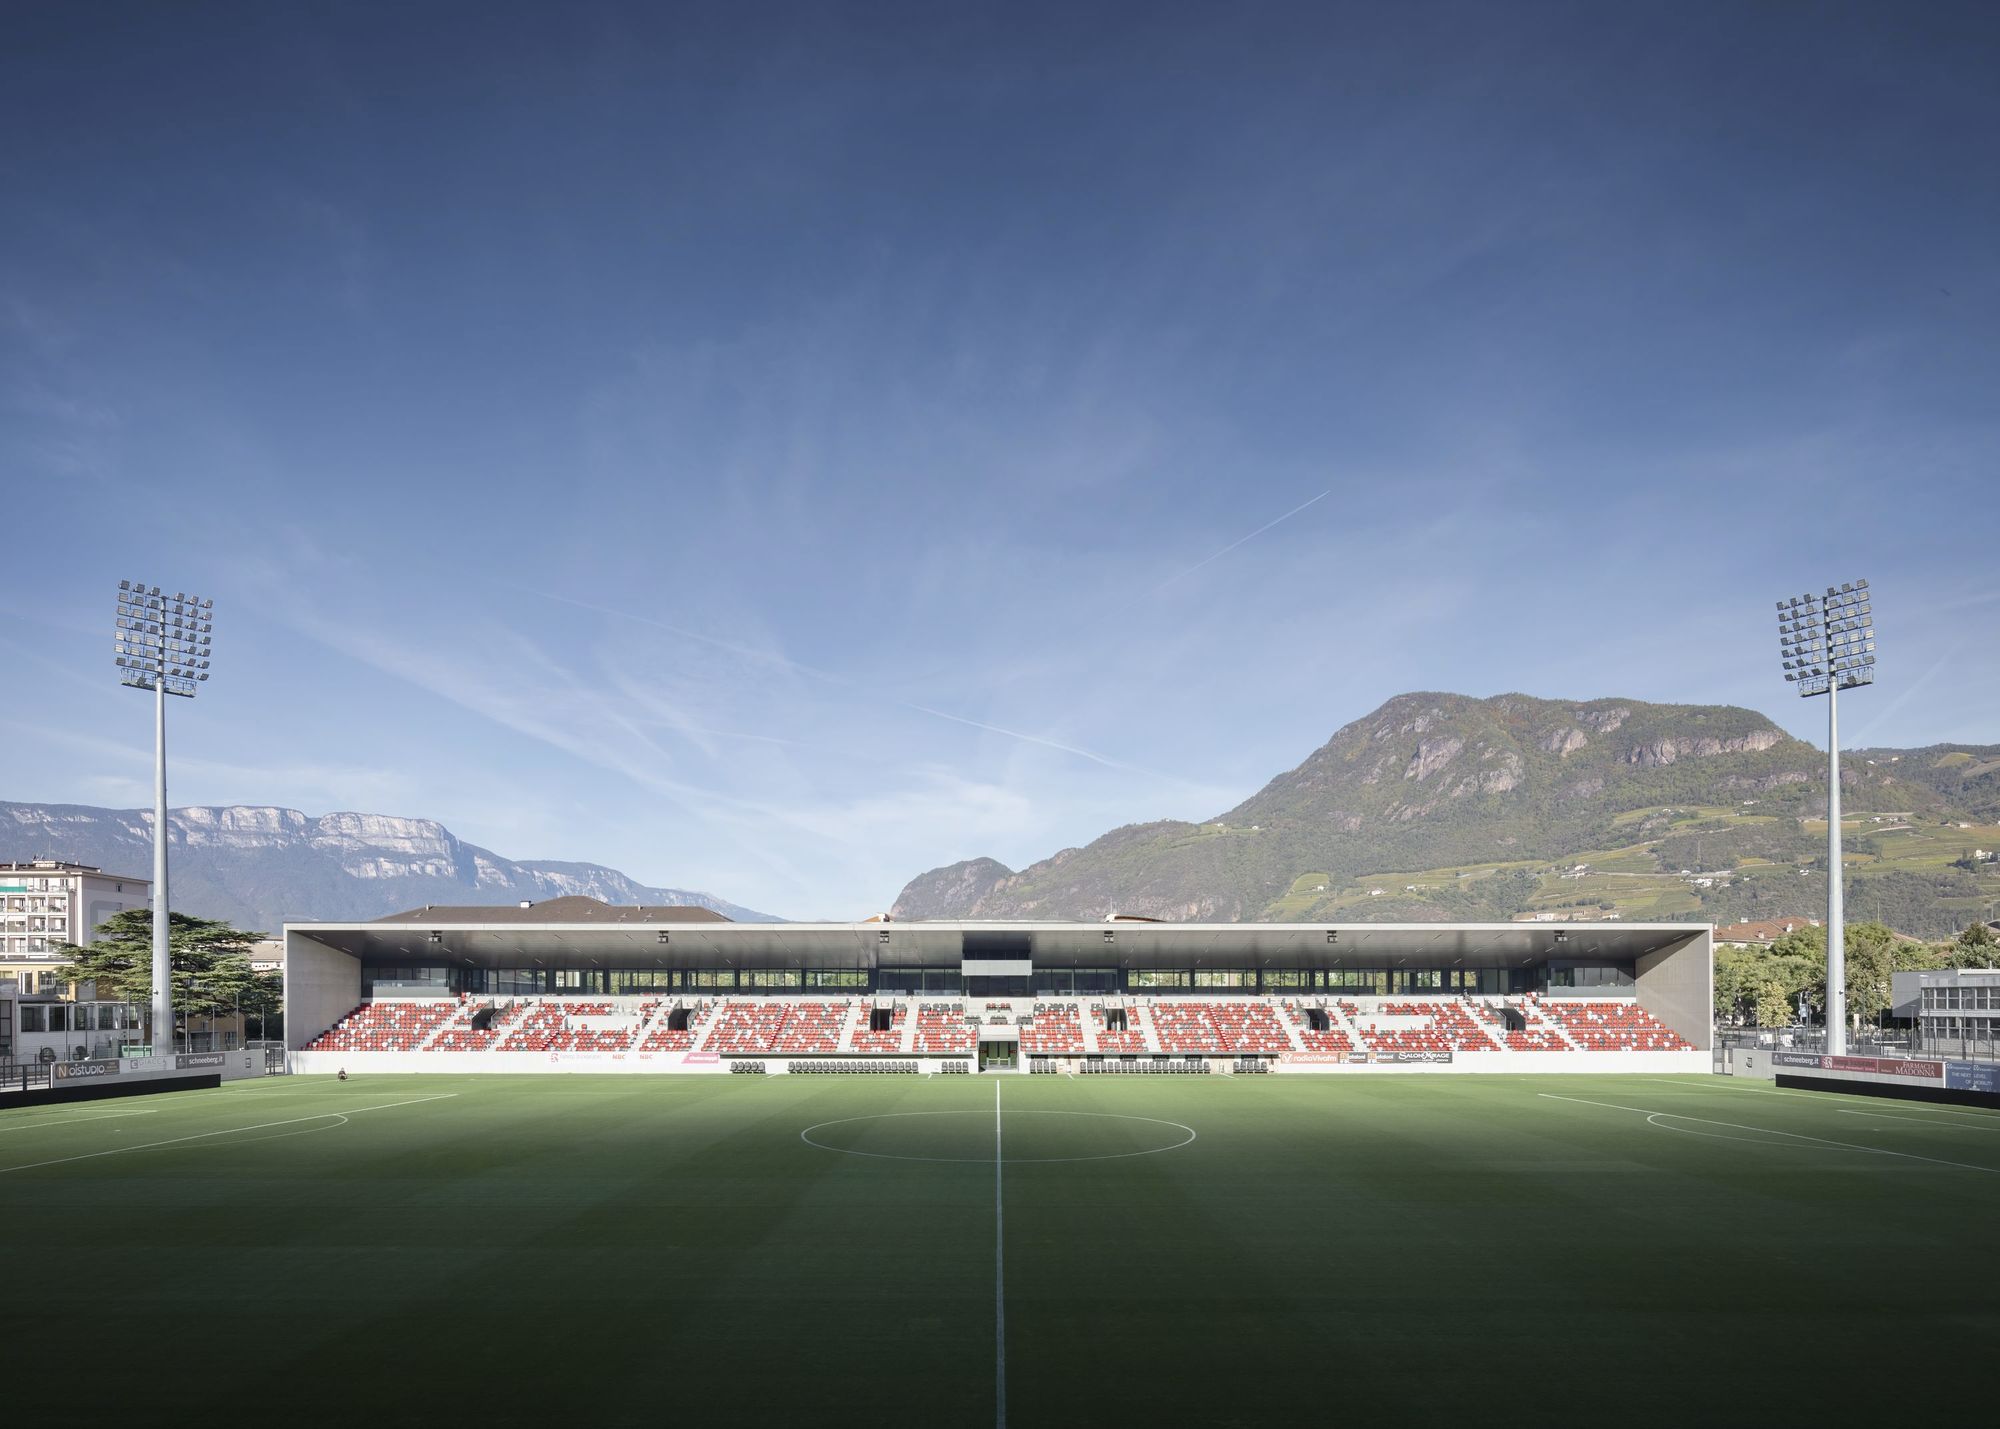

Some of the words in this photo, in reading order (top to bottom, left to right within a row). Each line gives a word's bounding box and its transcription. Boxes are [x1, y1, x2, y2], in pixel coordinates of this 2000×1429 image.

[189, 1055, 223, 1066] schneeberg.it
[1783, 1056, 1819, 1066] schneeberg.it
[1903, 1061, 1935, 1071] FARMACIA
[1895, 1066, 1936, 1077] MADONNA
